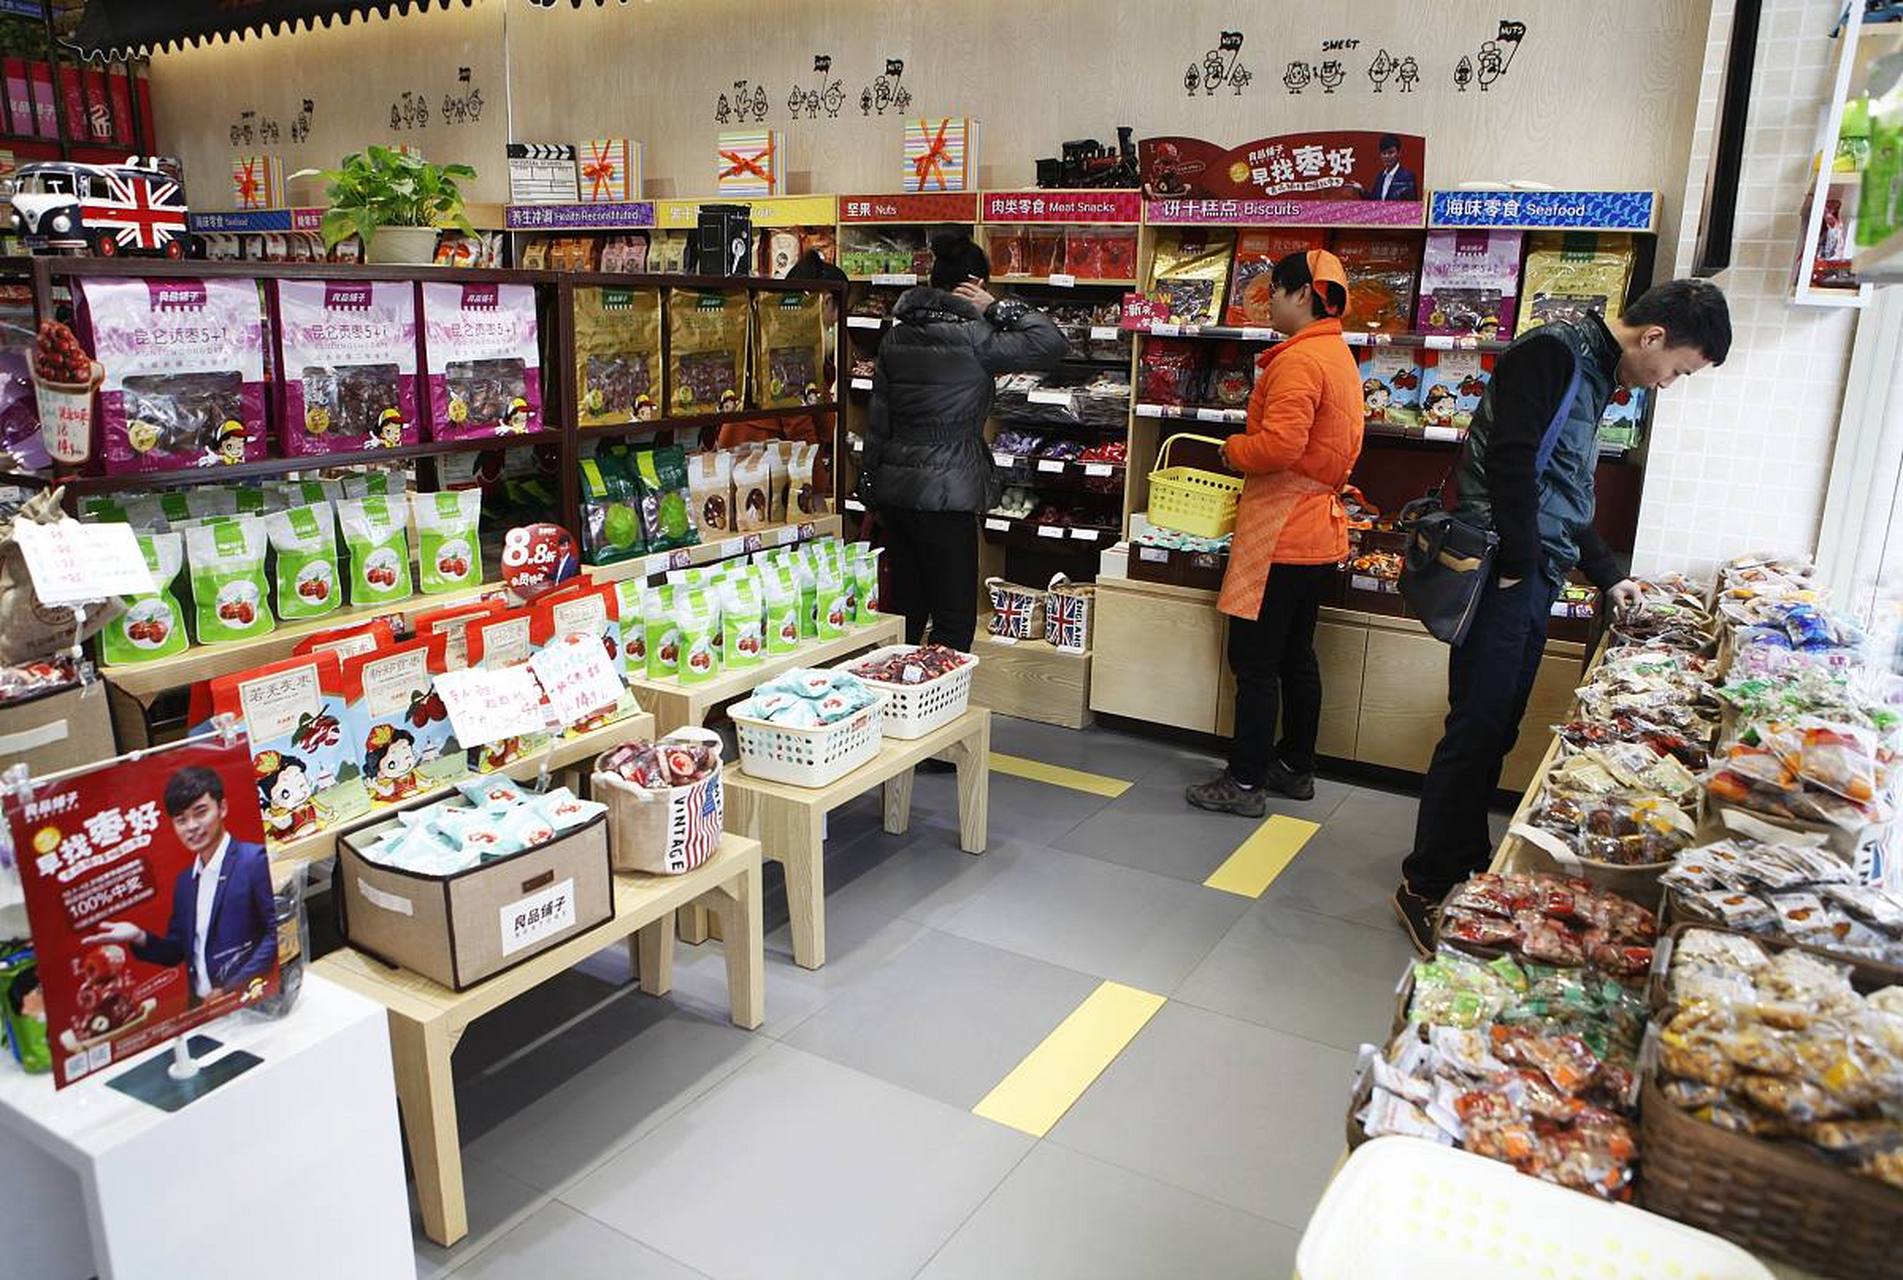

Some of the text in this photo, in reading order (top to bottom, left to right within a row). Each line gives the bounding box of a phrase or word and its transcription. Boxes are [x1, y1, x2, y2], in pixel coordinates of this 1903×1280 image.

[1501, 26, 1523, 35] NUTS
[1322, 39, 1360, 51] SWEET
[1252, 145, 1356, 186] 早找枣好
[847, 203, 897, 217] 坚果 Nuts
[991, 200, 1115, 213] 肉类零食 Meat Snacks
[1244, 202, 1300, 216] Biscuits
[1446, 199, 1585, 217] 海味零食 Seafood
[512, 209, 553, 225] 养生冲调
[160, 291, 200, 302] 良品铺子
[503, 527, 557, 567] 8.8折
[1073, 600, 1084, 648] ENGLAND
[668, 796, 686, 871] VINTAGE
[69, 875, 144, 917] 100%中奖
[514, 895, 567, 931] 良品铺子
